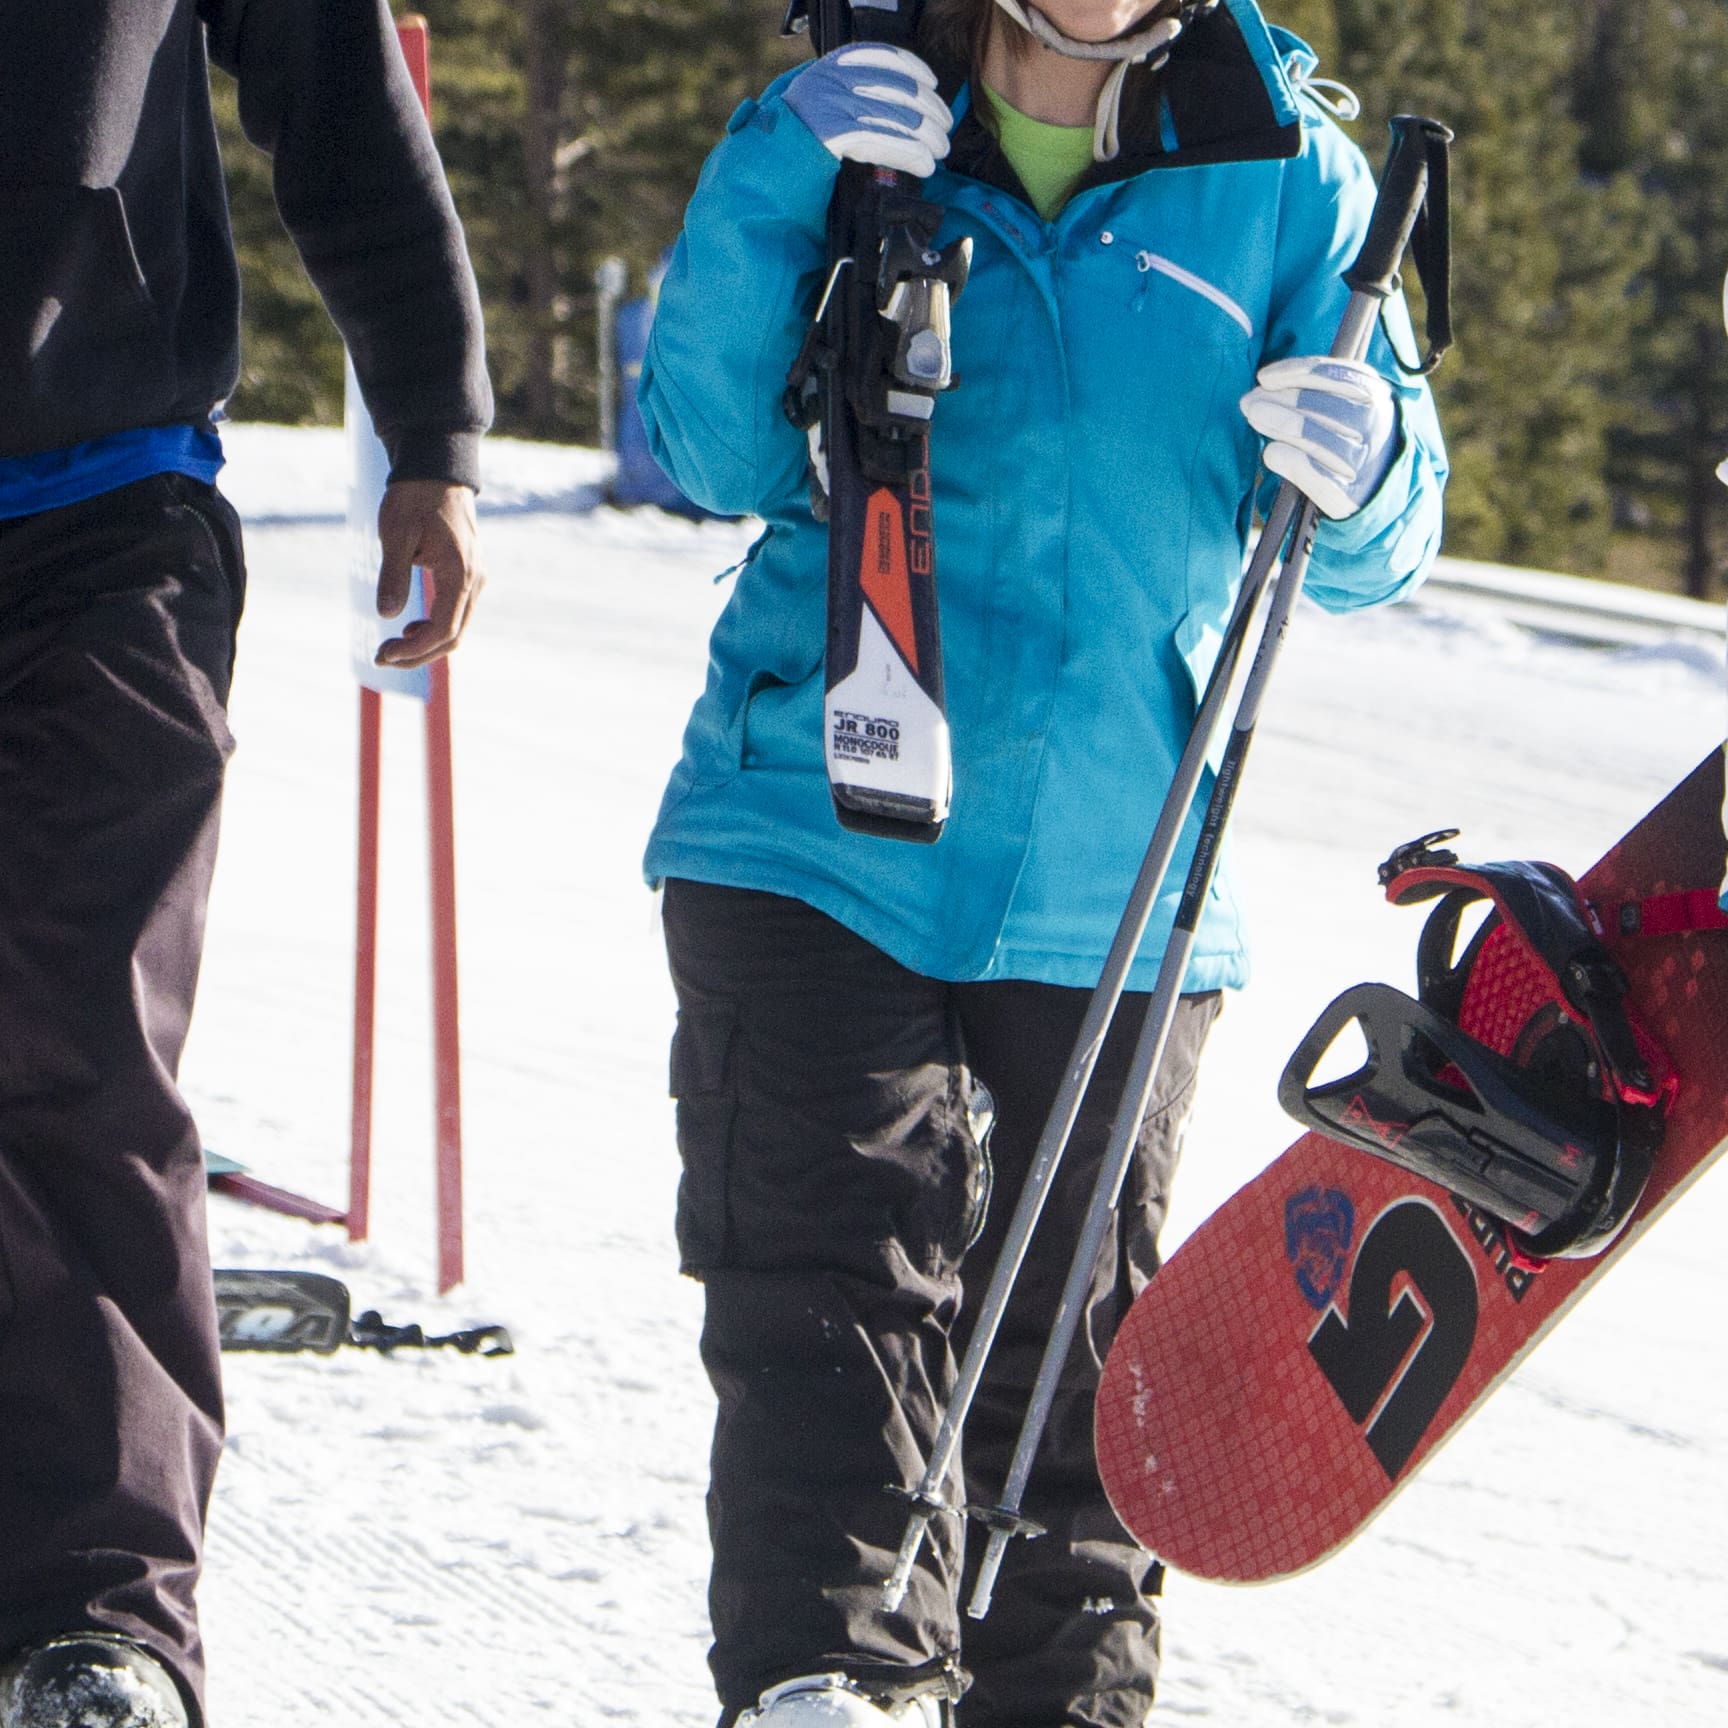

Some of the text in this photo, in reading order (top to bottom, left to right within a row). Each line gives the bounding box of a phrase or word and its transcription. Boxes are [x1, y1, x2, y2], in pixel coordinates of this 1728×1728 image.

[834, 718, 900, 741] JR 800
[1186, 833, 1215, 898] technology
